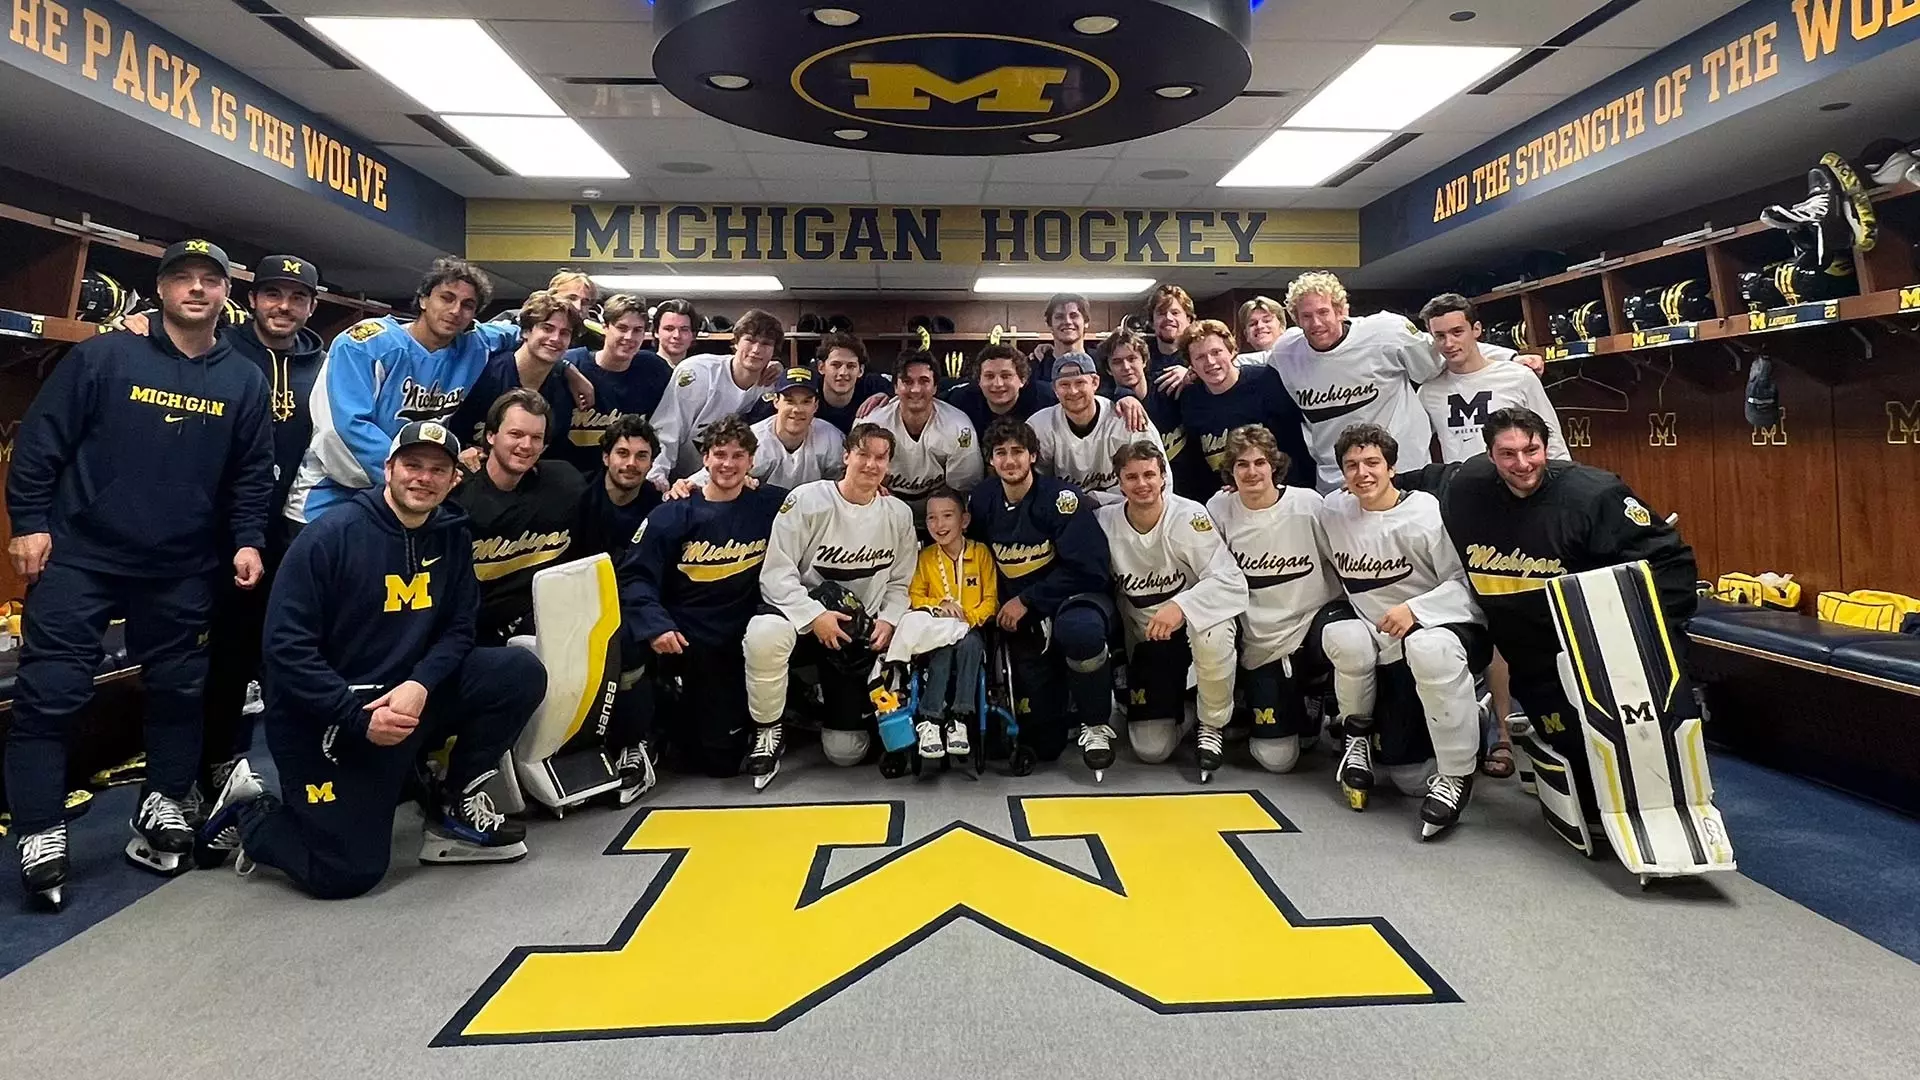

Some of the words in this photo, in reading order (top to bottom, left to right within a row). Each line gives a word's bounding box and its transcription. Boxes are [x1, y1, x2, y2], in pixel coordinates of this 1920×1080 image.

[849, 62, 1067, 112] M
[9, 0, 68, 65] HE
[82, 7, 201, 128] PACK
[210, 85, 237, 141] IS
[245, 103, 295, 169] THE
[301, 123, 388, 212] WOLVE
[1433, 175, 1469, 223] AND
[1472, 153, 1511, 205] THE
[1515, 86, 1646, 186] STRENGTH
[1654, 64, 1692, 126] OF
[1702, 21, 1779, 103] THE
[569, 203, 942, 262] MICHIGAN
[981, 209, 1267, 263] HOCKEY
[185, 240, 210, 253] M
[282, 259, 302, 275] M
[130, 385, 225, 417] MICHIGAN
[1296, 383, 1375, 406] Michigan
[1448, 391, 1493, 427] M
[1649, 412, 1677, 446] M
[472, 529, 570, 560] Michigan
[681, 538, 766, 563] Michigan
[818, 545, 893, 567] Michigan
[1335, 553, 1408, 578] Michigan
[1467, 543, 1562, 578] Michigan
[383, 572, 433, 612] M
[965, 576, 979, 587] M
[1114, 568, 1181, 593] Michigan
[1254, 707, 1277, 726] M
[1541, 712, 1566, 734] M
[1620, 701, 1655, 725] M
[306, 781, 337, 804] M
[428, 790, 1464, 1047] M
